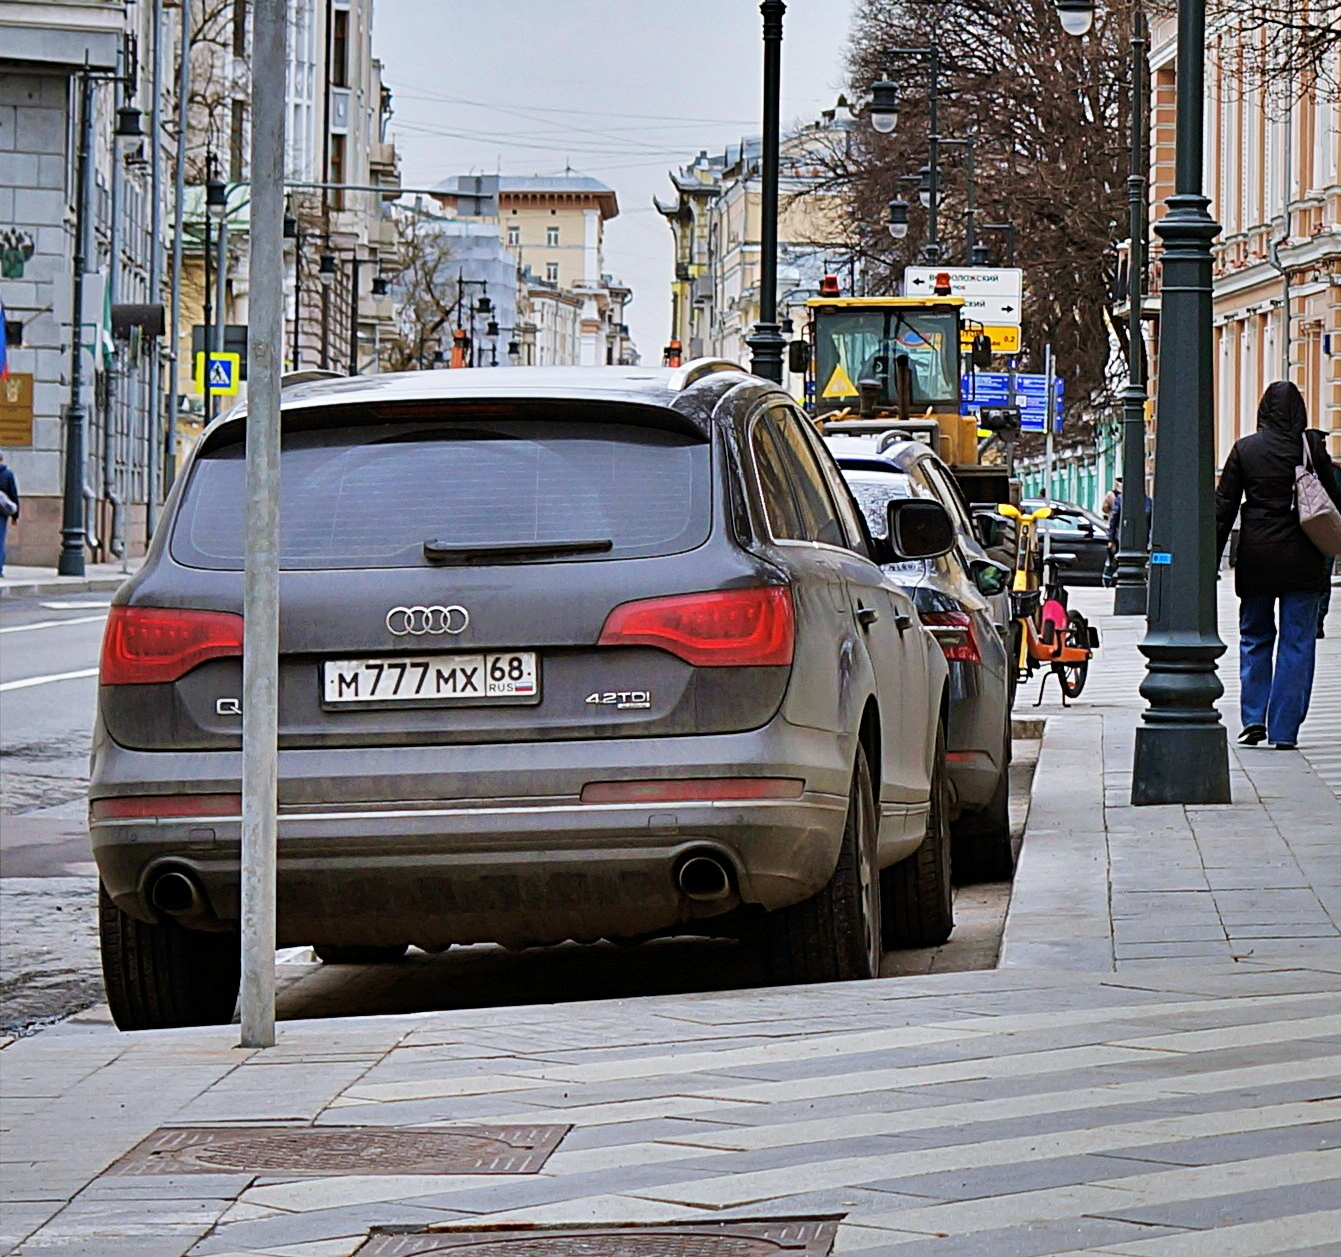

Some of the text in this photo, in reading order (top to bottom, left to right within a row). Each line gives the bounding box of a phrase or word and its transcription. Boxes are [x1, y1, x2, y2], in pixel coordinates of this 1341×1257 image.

[928, 273, 999, 283] ВОЛОЖСКИЙ
[489, 656, 524, 682] 68
[488, 683, 514, 693] RUS
[216, 698, 242, 715] Q
